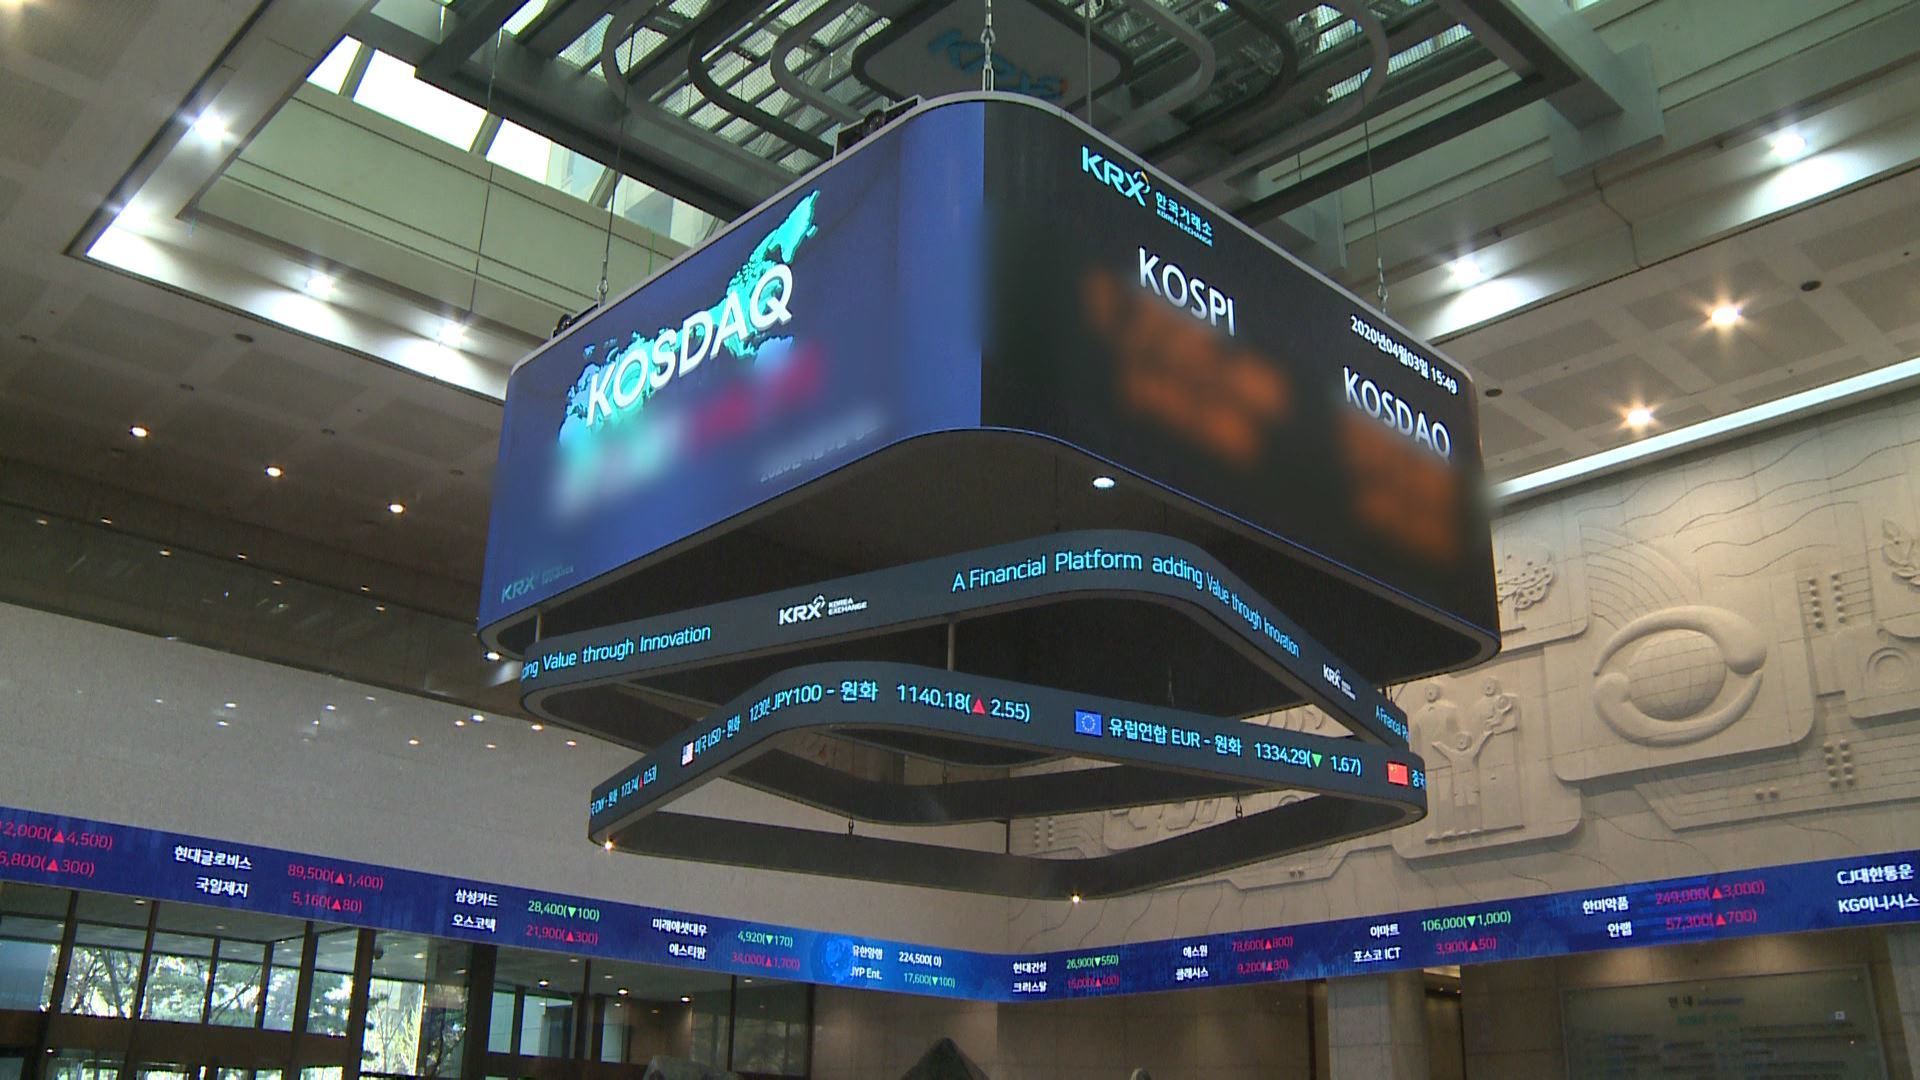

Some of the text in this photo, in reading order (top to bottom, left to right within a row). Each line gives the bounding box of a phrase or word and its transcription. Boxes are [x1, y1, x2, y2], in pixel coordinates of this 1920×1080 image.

[1082, 146, 1150, 207] KRX
[1155, 191, 1213, 237] 한국거래소
[1138, 246, 1236, 337] KOSPI
[584, 263, 794, 427] KOSDAQ
[1431, 366, 1459, 395] 15:49
[501, 575, 535, 604] KRX
[779, 595, 826, 625] KRX
[952, 548, 1300, 659] A Financial Platform adding Value through Innovation
[543, 651, 577, 672] Value
[583, 639, 635, 663] through
[640, 625, 712, 653] Innovation
[840, 680, 879, 702] 원화
[707, 727, 722, 748] USD
[727, 714, 741, 739] 원화
[1109, 718, 1167, 744] 유럽연합
[1171, 729, 1200, 748] EUR
[1214, 724, 1242, 756] 원화
[174, 845, 252, 870] 현대글로비스
[1837, 863, 1914, 885] CJ대한통운
[196, 877, 249, 898] 국일제지
[455, 889, 499, 907] 삼성카드
[1582, 896, 1629, 915] 한미약품
[1838, 893, 1920, 913] KG이니시스
[452, 914, 497, 933] 오스코텍
[652, 917, 708, 937] 미래에셋대우
[1370, 923, 1400, 938] 이마트
[1607, 921, 1633, 938] 안랩
[669, 943, 706, 960] 에스티팜
[1182, 944, 1208, 958] 에스원
[1353, 949, 1383, 963] 포스코
[1384, 947, 1401, 961] ICT
[850, 966, 866, 977] JYP
[866, 967, 883, 980] Ent.
[1012, 980, 1048, 993] 크리스탈
